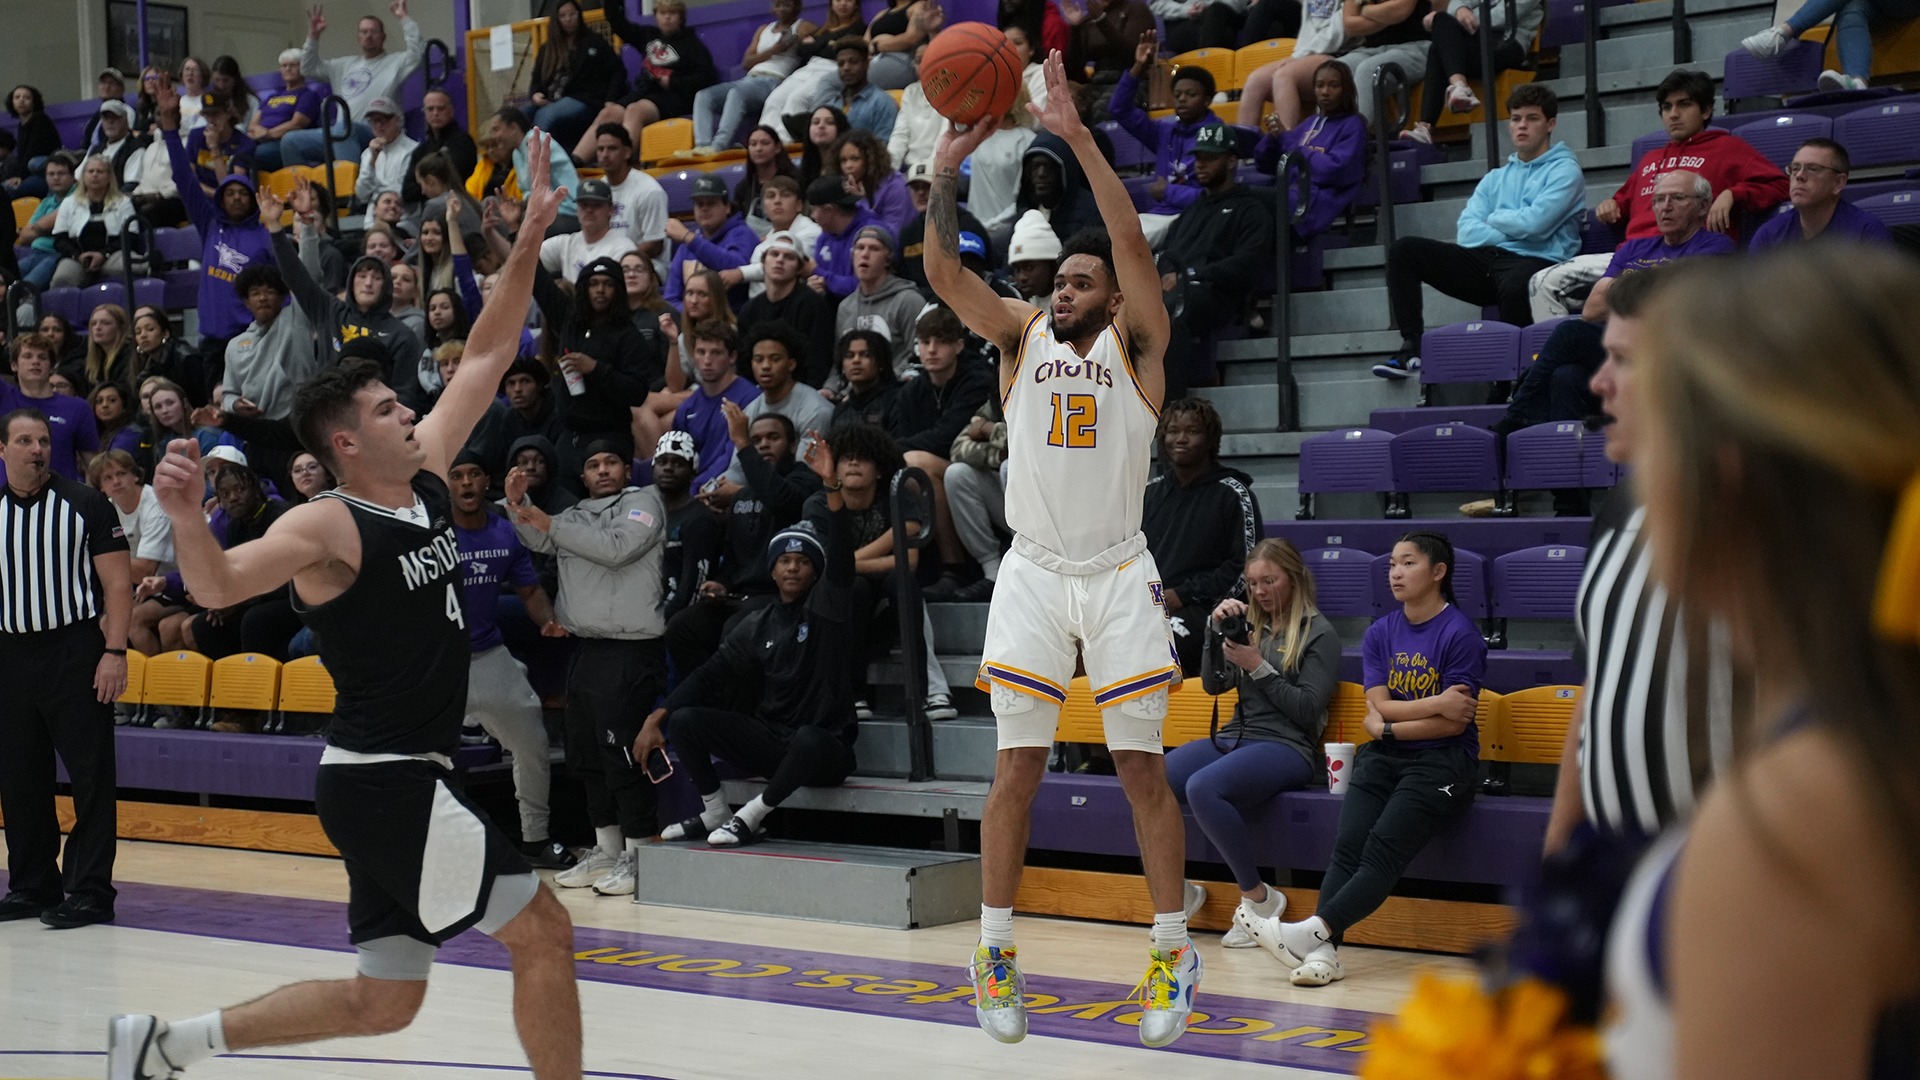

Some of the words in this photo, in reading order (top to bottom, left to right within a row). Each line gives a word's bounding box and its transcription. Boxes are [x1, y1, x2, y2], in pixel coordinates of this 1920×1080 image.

[1046, 391, 1097, 449] 12
[474, 548, 510, 560] WESLEYAN
[445, 582, 465, 630] 4
[1411, 652, 1428, 669] Our
